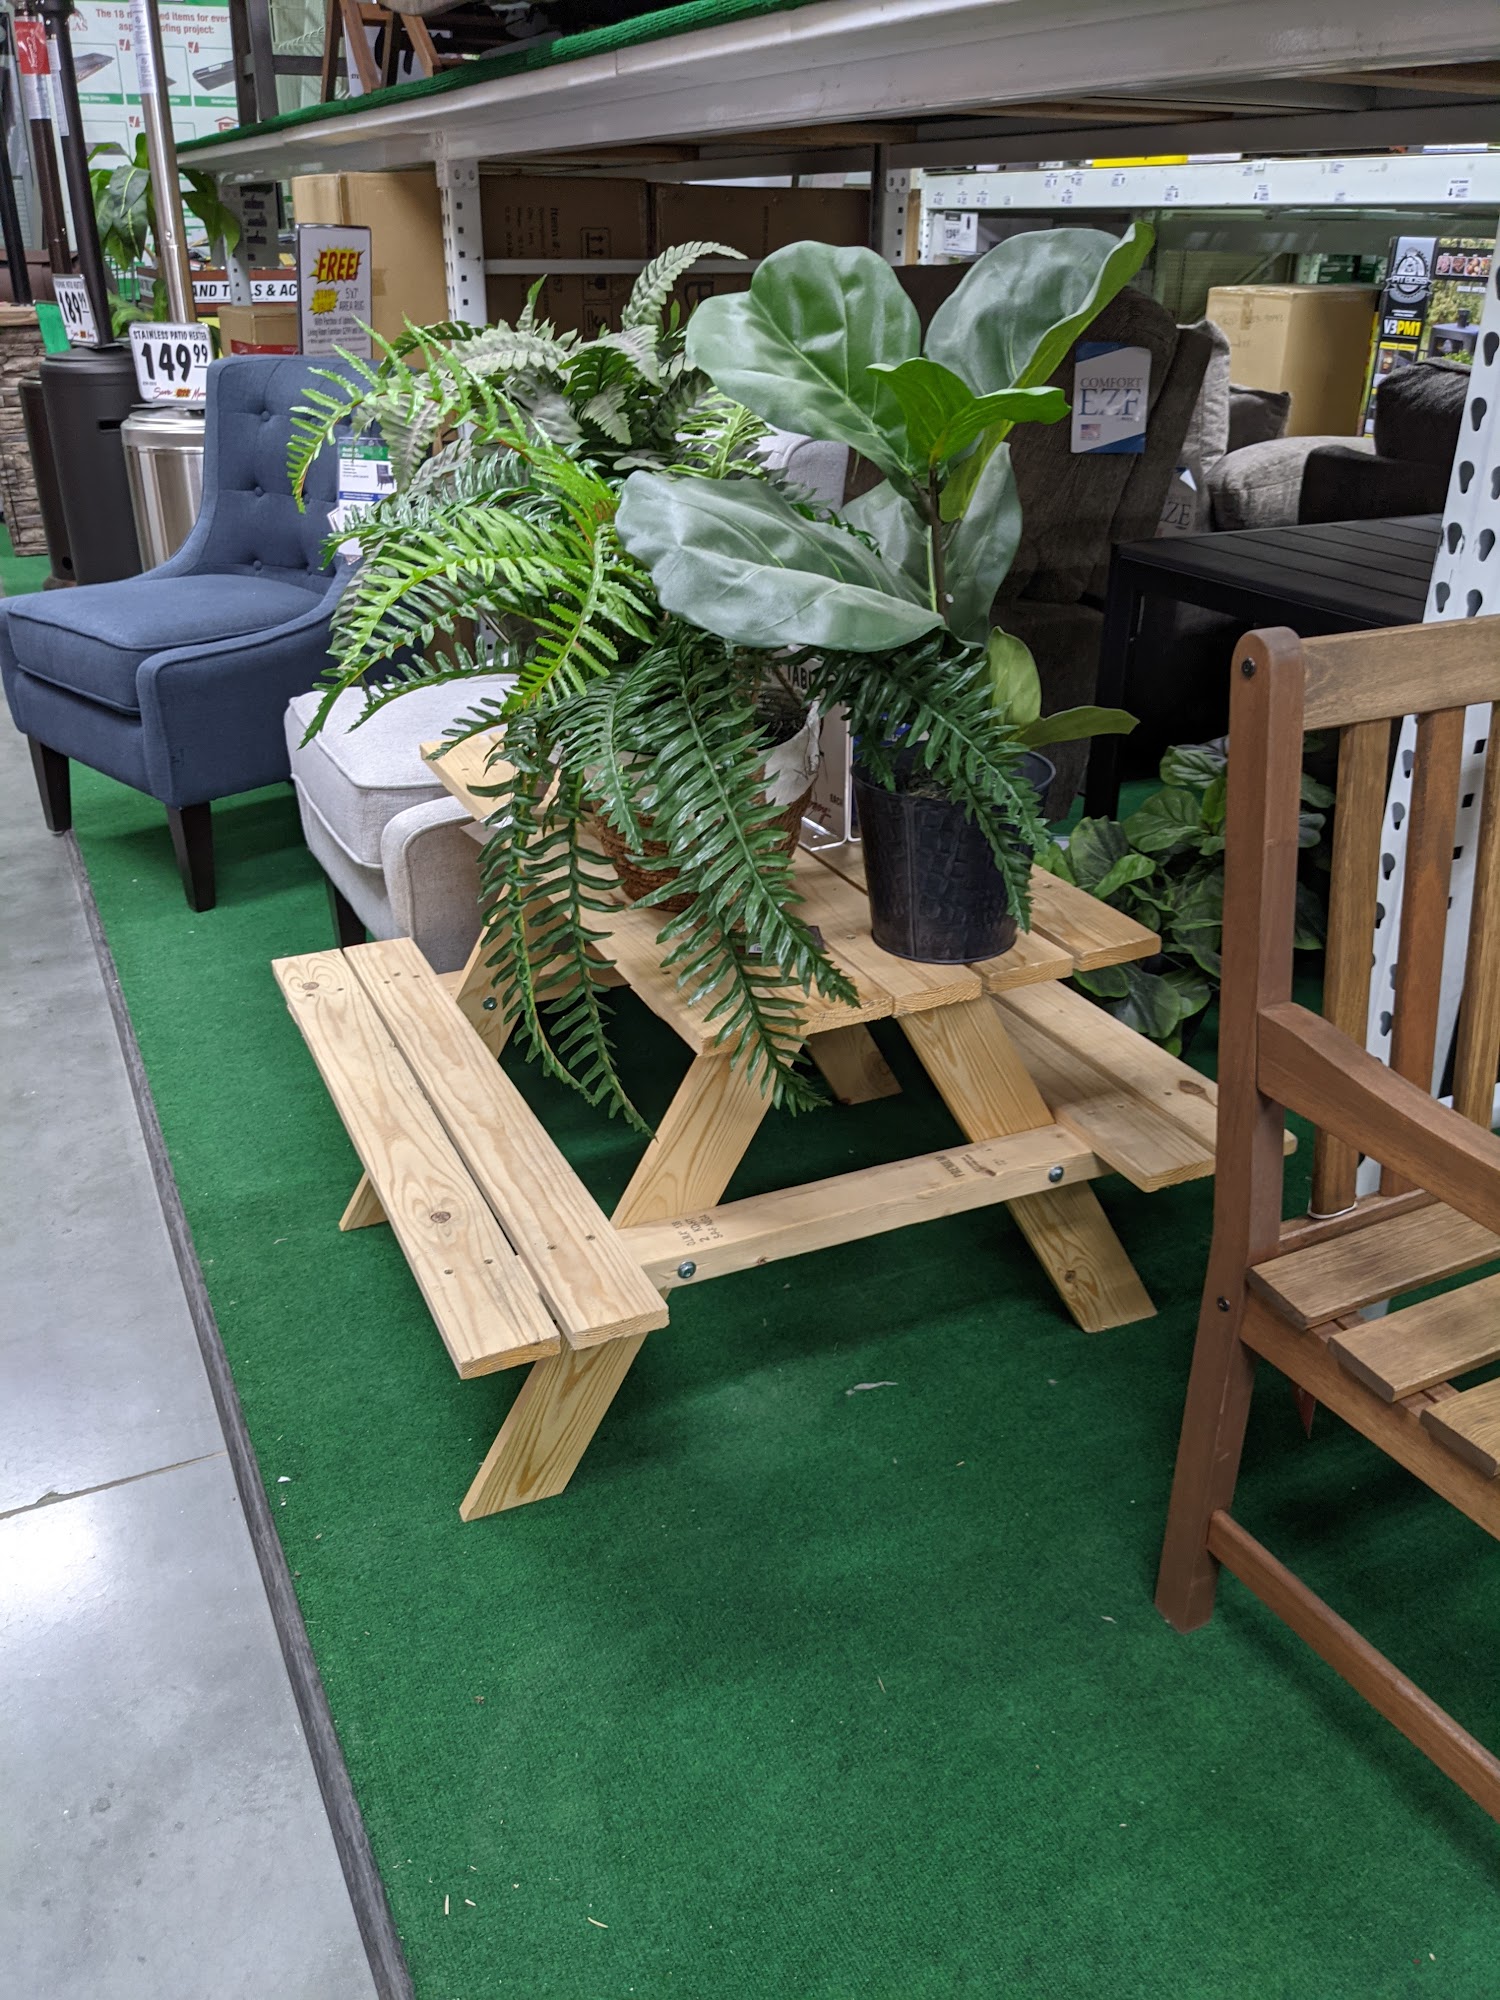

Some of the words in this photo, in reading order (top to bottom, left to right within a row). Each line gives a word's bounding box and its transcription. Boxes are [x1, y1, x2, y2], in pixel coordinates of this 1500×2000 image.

[96, 8, 111, 18] The
[114, 10, 125, 18] 18
[171, 11, 195, 21] items
[196, 13, 209, 22] for
[183, 25, 215, 35] project:
[317, 251, 361, 281] FREE!
[192, 284, 217, 297] AND
[266, 284, 277, 297] &
[280, 283, 297, 297] AC
[58, 290, 83, 326] 189
[133, 330, 169, 340] STAINLESS
[170, 330, 188, 341] PATIO
[189, 331, 208, 341] HEATER
[141, 342, 192, 382] 149
[1080, 378, 1143, 389] COMFORT
